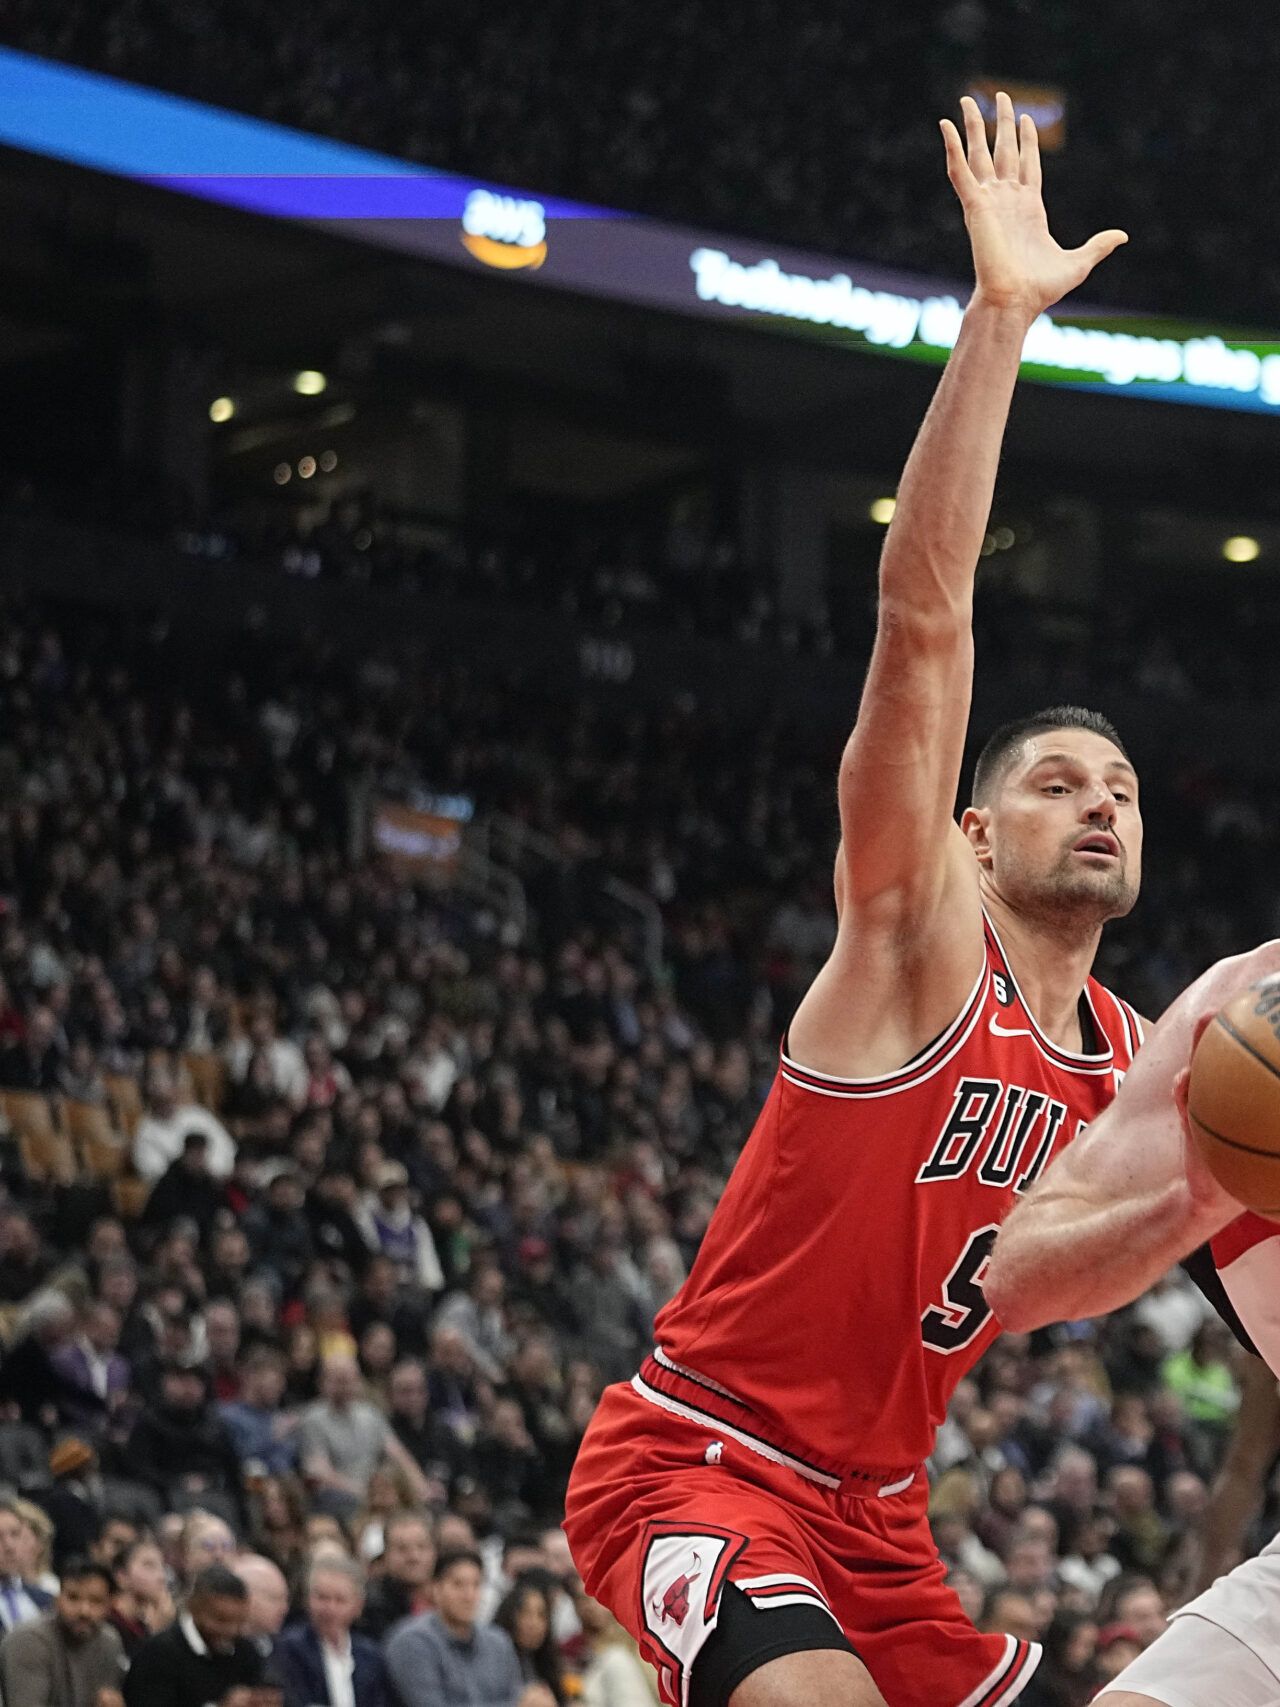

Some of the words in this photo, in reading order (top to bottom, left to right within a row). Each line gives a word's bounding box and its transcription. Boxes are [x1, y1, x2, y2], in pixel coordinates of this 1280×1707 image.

[689, 248, 921, 348] Technology
[1182, 336, 1261, 391] the
[993, 974, 1008, 1004] 6
[914, 1077, 1090, 1196] BUL
